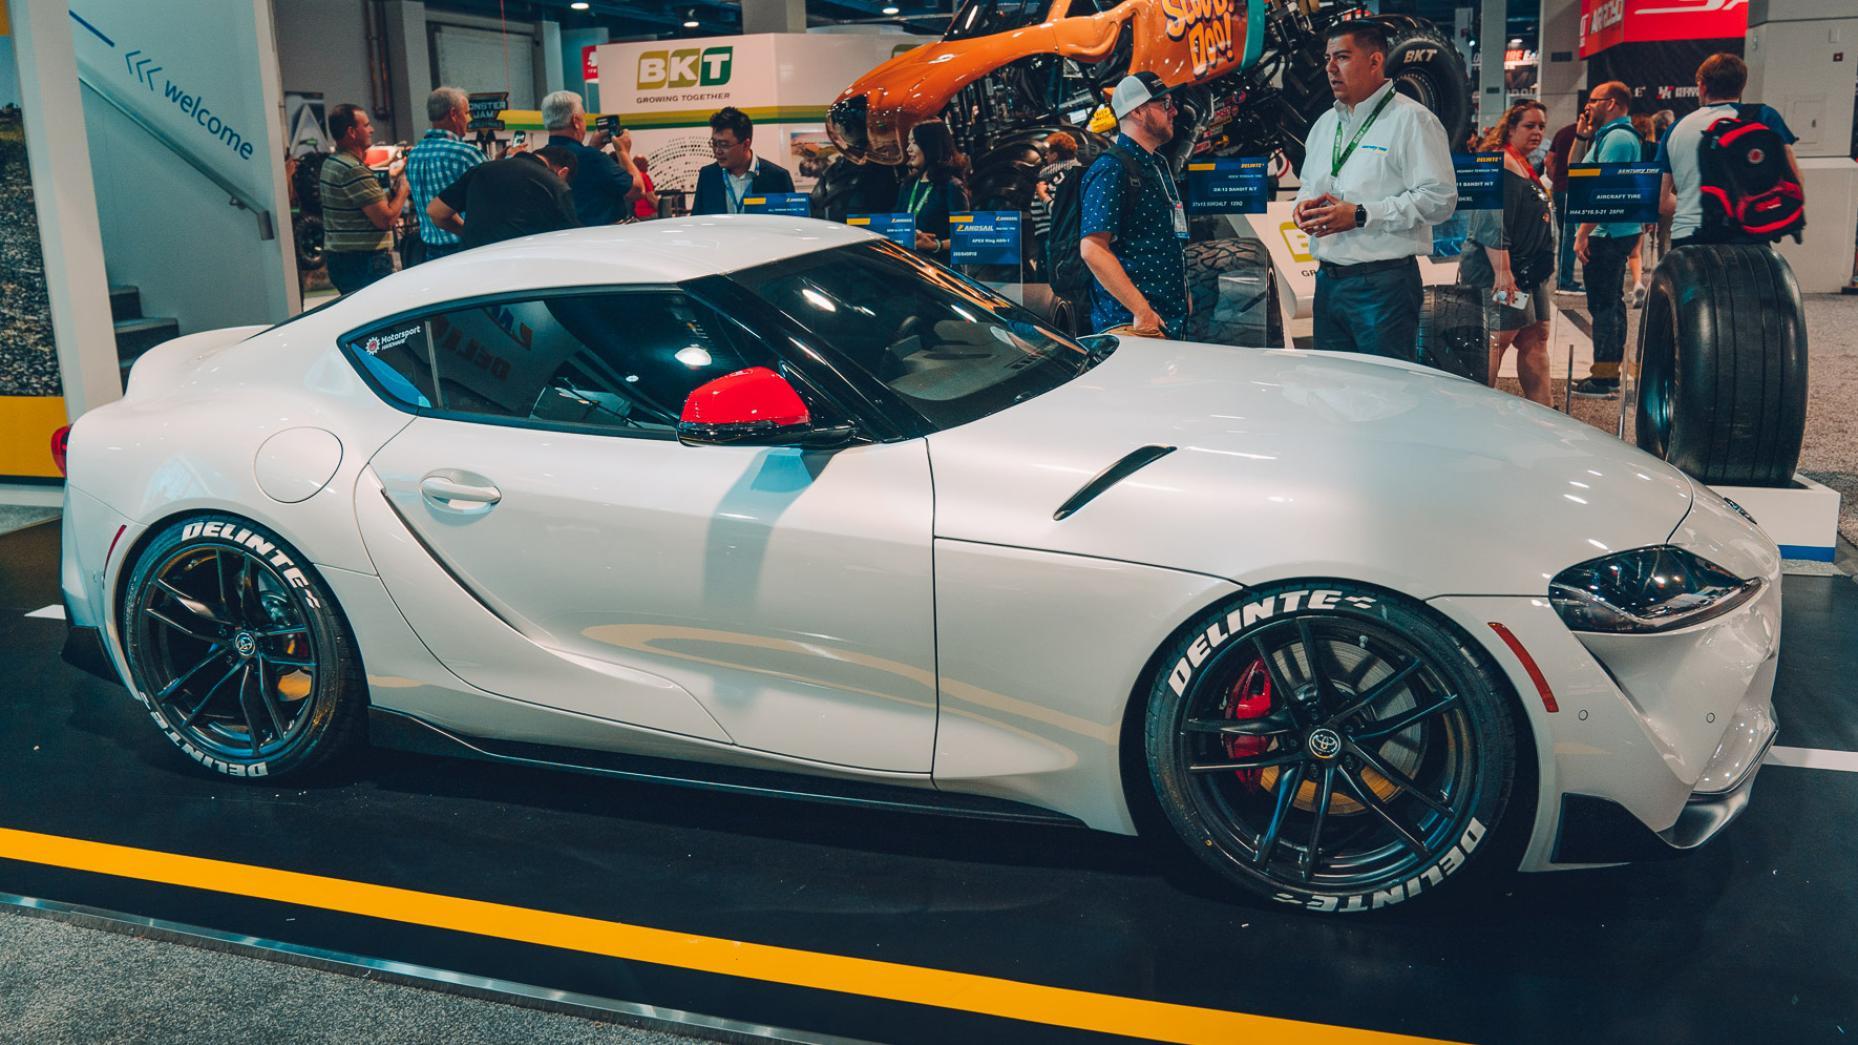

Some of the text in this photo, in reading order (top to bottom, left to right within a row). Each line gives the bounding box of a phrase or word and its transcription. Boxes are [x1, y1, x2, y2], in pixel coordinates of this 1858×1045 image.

[638, 51, 731, 86] BKT
[1404, 49, 1437, 63] BKT
[165, 80, 253, 160] welcome
[636, 92, 730, 104] GROWING TOGETHER
[381, 326, 421, 344] Motorsport
[182, 521, 310, 589] DELINTE
[1168, 589, 1342, 697] DELINTE
[1306, 817, 1487, 913] DELINTE
